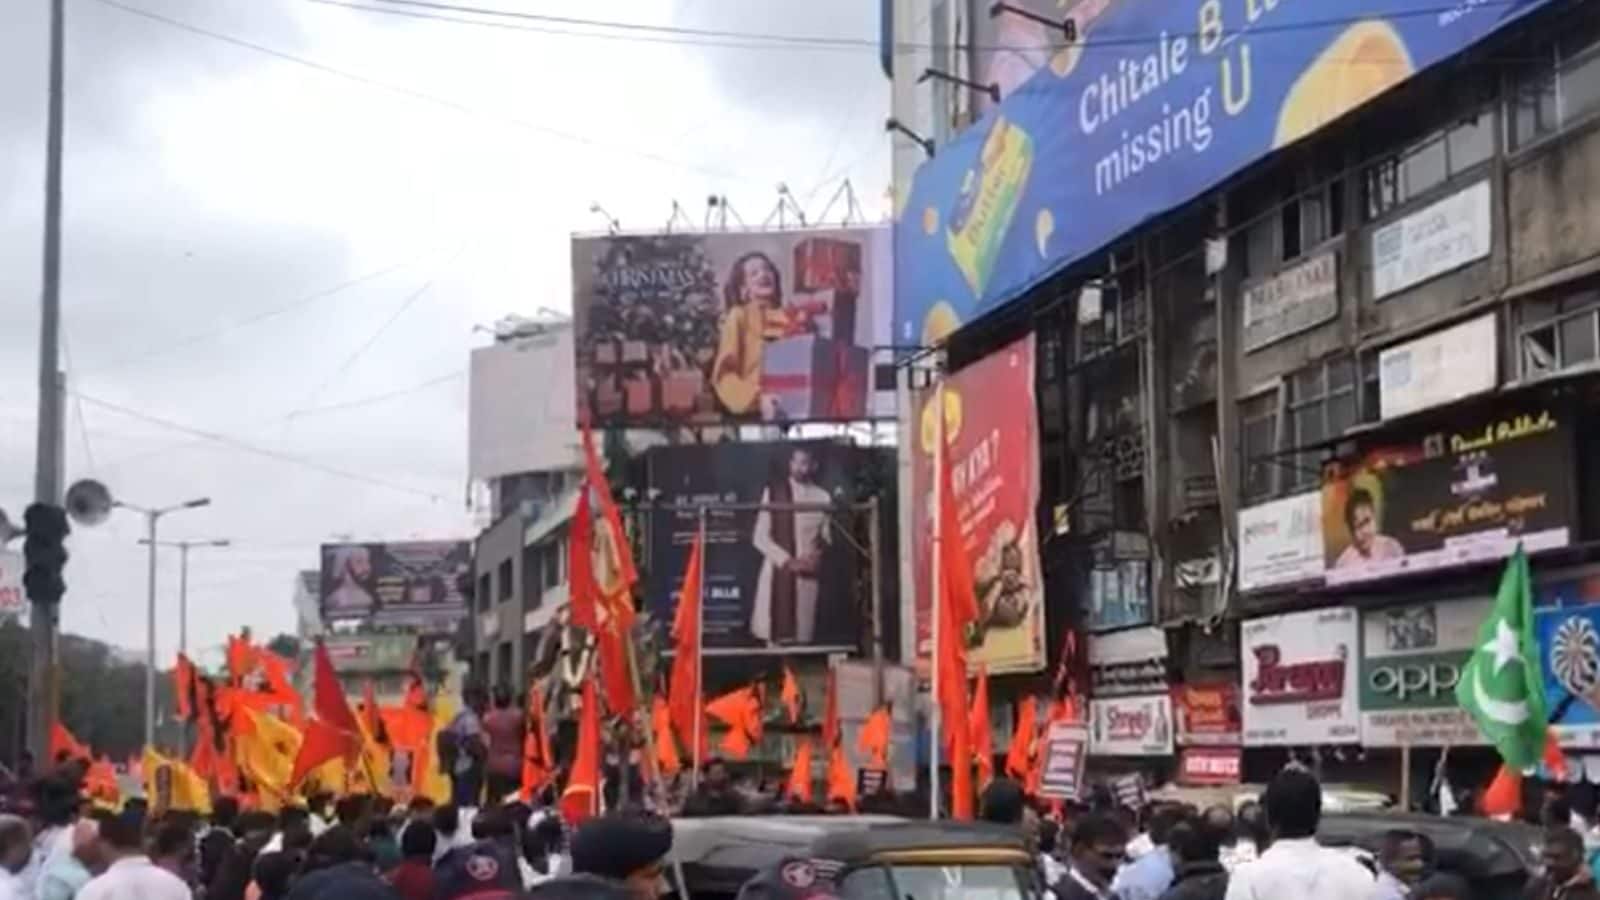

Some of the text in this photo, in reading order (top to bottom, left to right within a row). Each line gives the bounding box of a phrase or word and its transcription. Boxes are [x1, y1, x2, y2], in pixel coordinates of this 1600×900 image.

[1079, 30, 1188, 134] Chitale
[1095, 43, 1251, 195] missing U
[1368, 664, 1460, 699] opp
